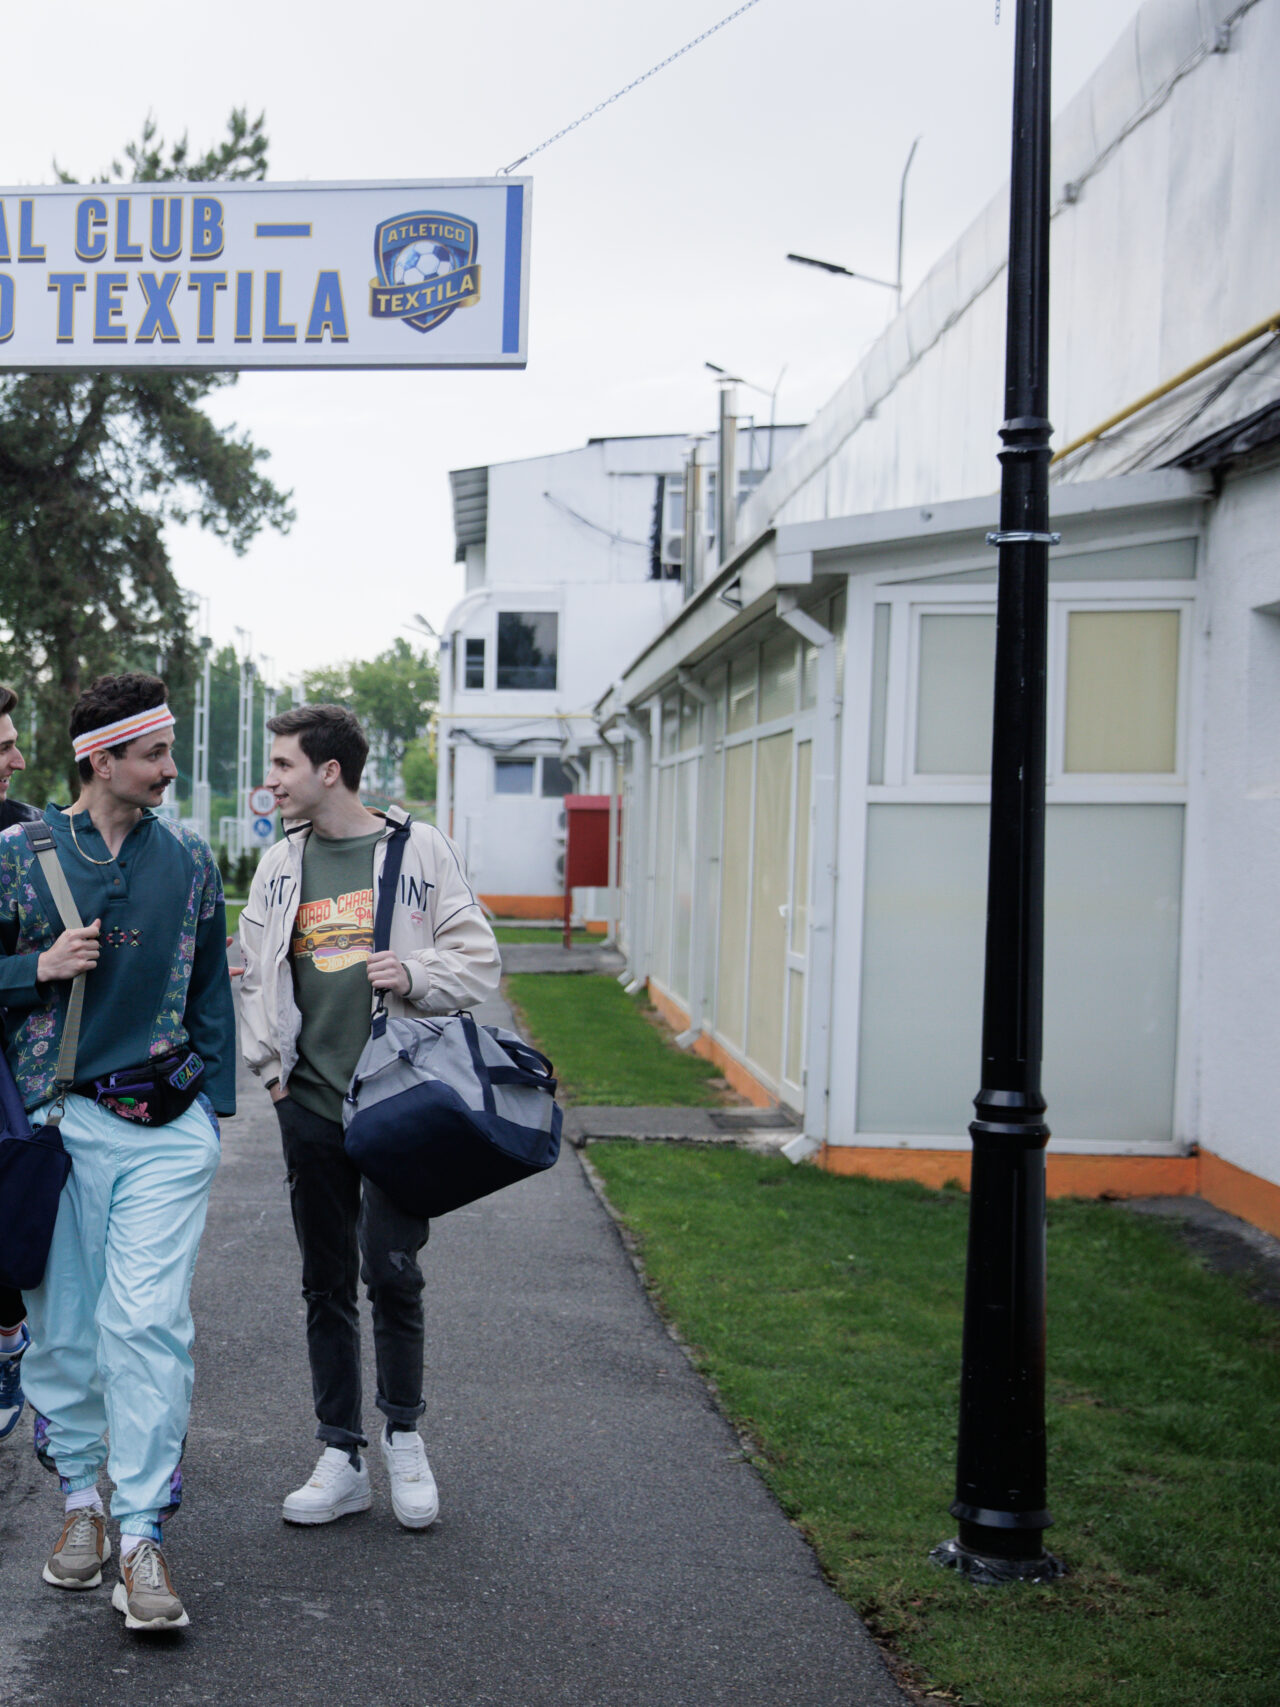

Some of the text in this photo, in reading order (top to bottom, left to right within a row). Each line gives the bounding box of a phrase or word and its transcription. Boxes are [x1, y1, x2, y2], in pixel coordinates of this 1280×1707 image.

[74, 196, 225, 264] CLUB
[387, 223, 465, 244] ATLETICO
[47, 269, 350, 343] TEXTILA
[376, 274, 475, 312] TEXTILA
